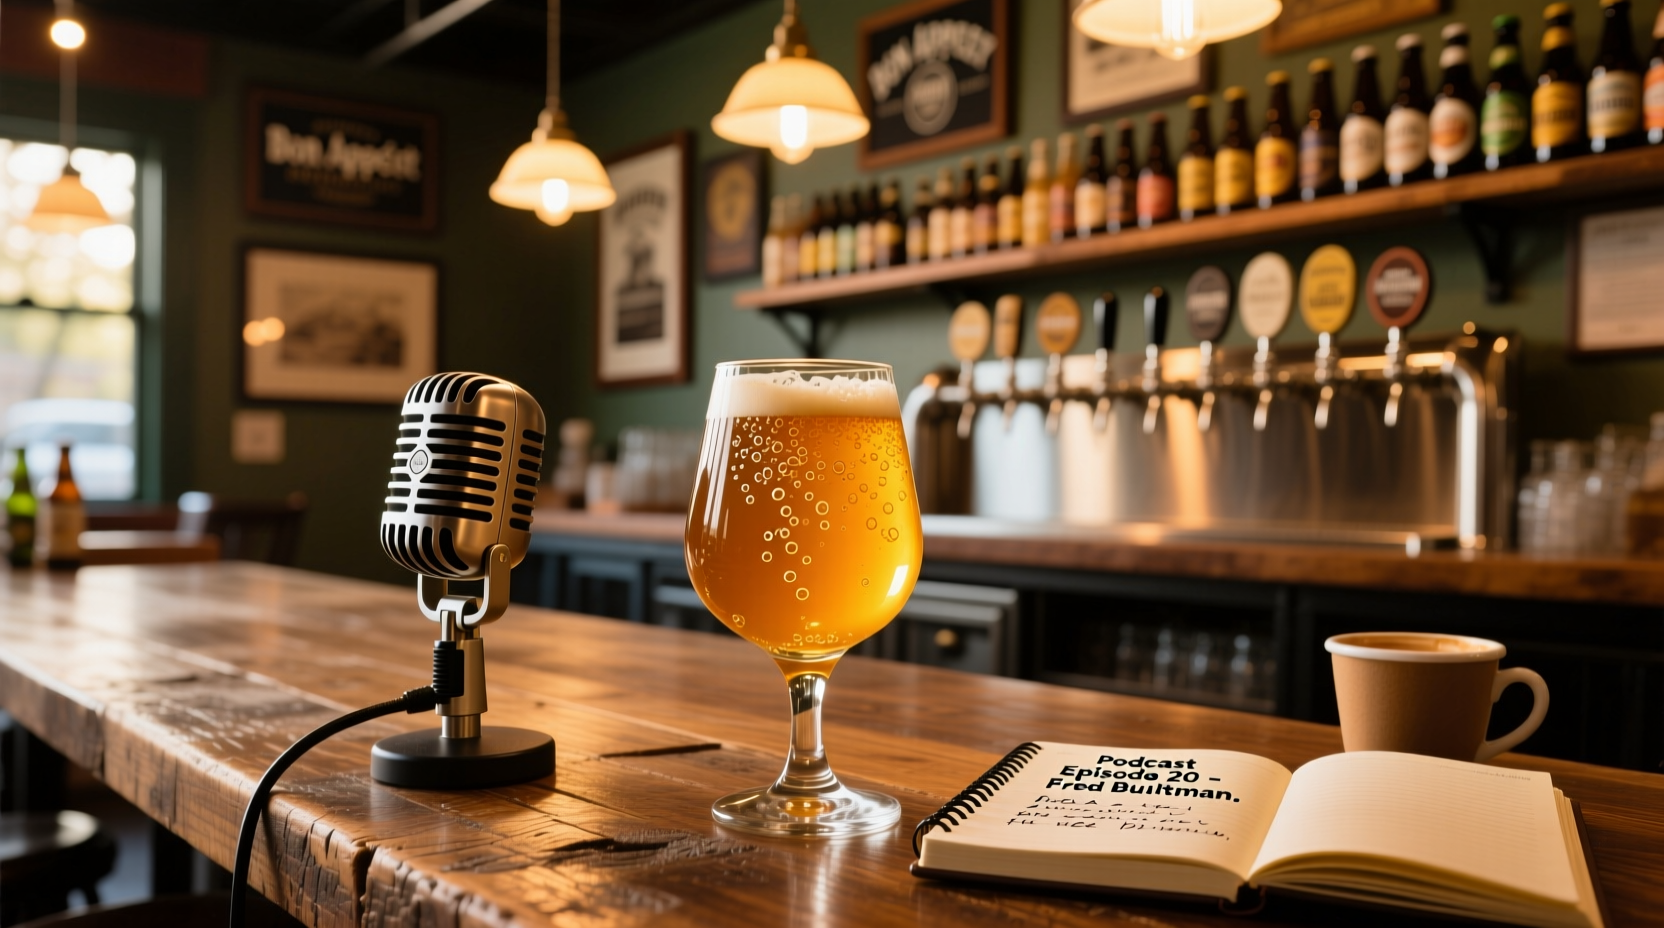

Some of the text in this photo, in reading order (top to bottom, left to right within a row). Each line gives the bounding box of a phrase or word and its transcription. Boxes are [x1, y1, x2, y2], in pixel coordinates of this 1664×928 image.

[1096, 754, 1197, 770] Podcast
[1166, 770, 1200, 783] 20
[1046, 778, 1105, 792] Fred
[1111, 781, 1240, 803] Builtman.
